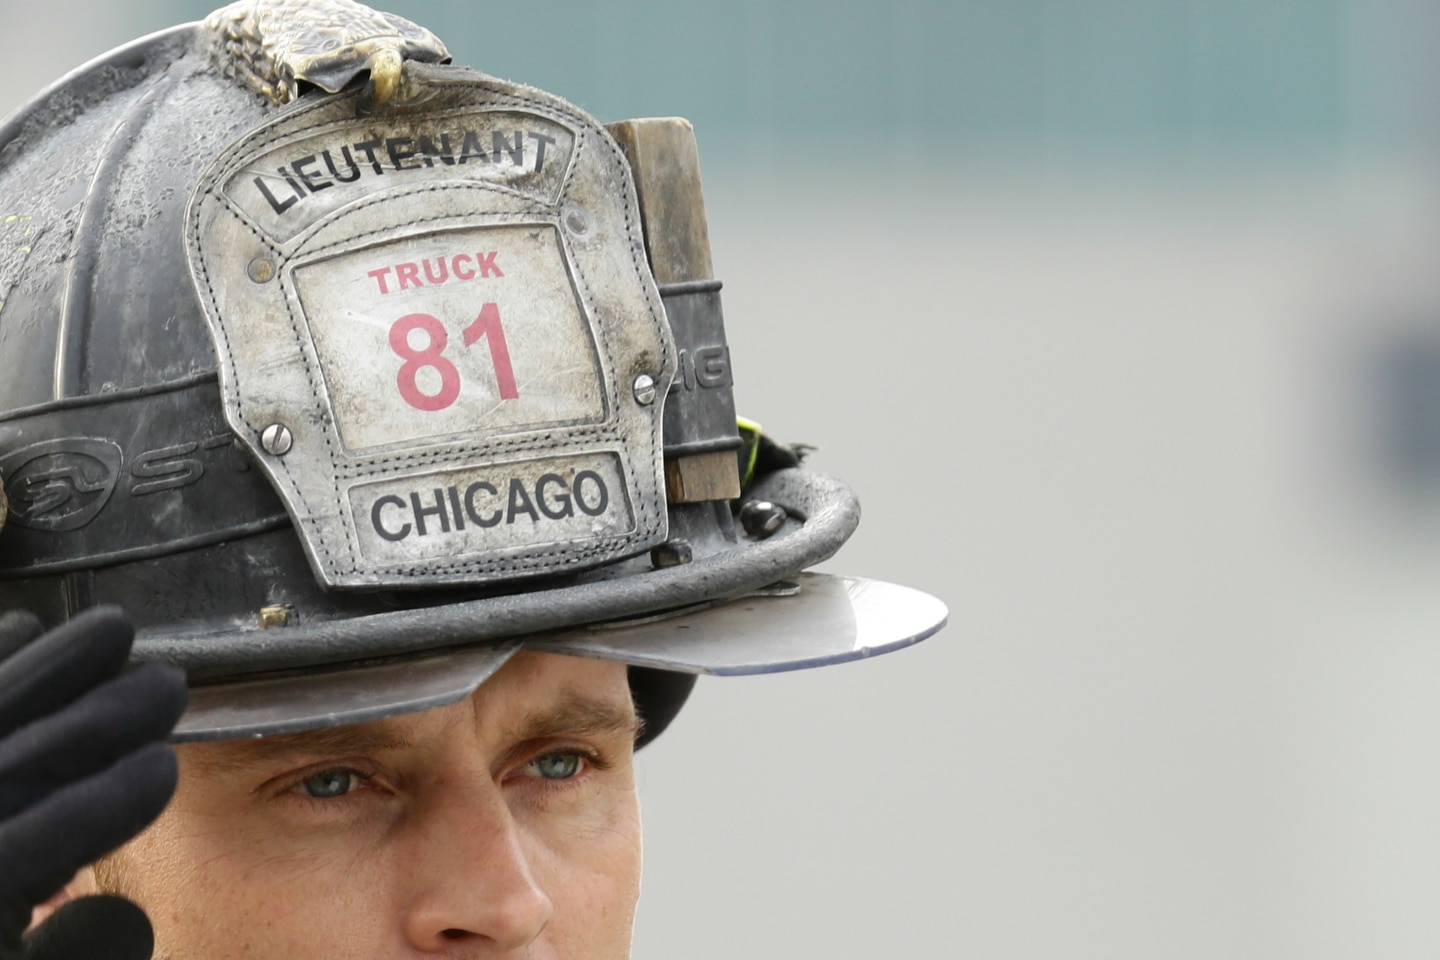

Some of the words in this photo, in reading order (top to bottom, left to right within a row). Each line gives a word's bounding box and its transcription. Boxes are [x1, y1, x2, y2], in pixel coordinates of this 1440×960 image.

[253, 130, 556, 215] LIEUTENANT
[368, 251, 505, 294] TRUCK
[388, 302, 520, 412] 81
[370, 469, 609, 542] CHICAGO
